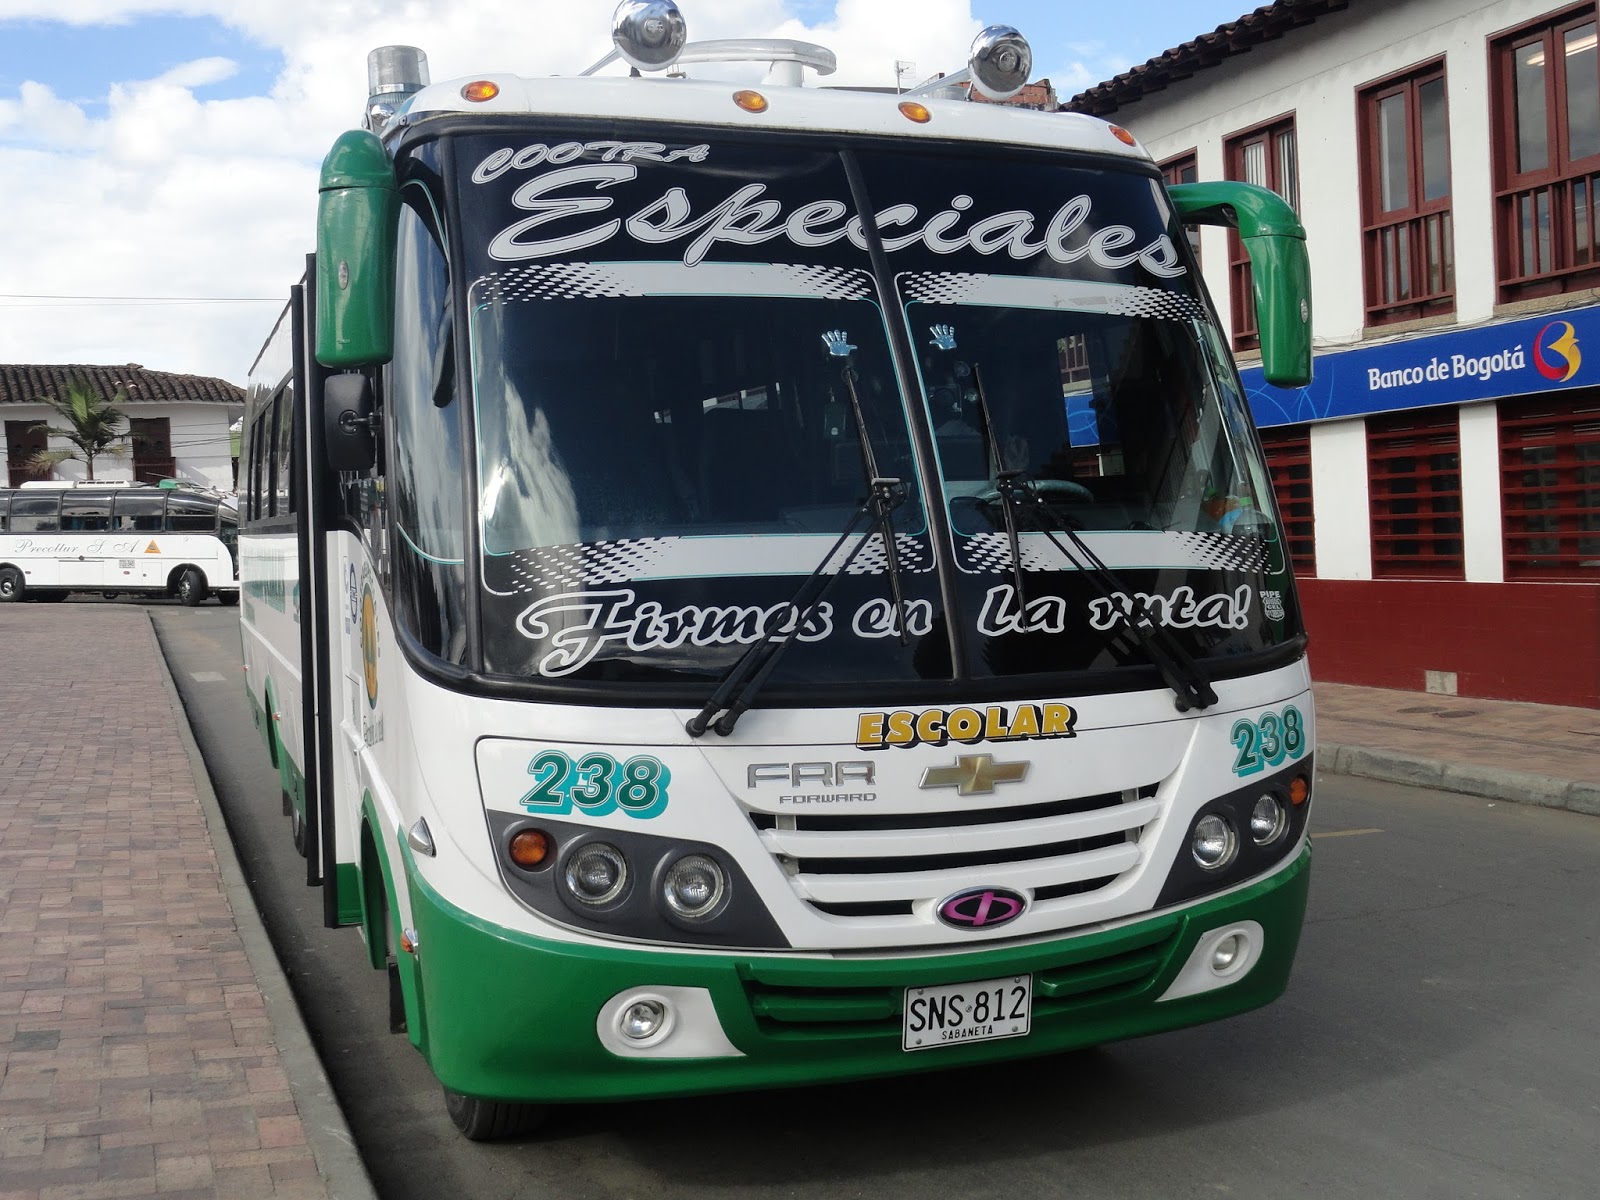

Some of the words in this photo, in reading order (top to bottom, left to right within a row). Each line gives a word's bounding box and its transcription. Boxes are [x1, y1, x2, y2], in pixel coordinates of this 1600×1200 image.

[472, 140, 710, 184] COOTRA
[488, 163, 1187, 278] Especiales
[1367, 366, 1424, 391] Banco
[1425, 357, 1450, 382] de
[1451, 344, 1526, 381] Bogotá
[1259, 590, 1281, 598] PIPE
[515, 588, 834, 678] Firmes
[852, 598, 933, 639] en
[856, 702, 1078, 751] ESCOLAR
[1230, 704, 1305, 778] 238
[519, 749, 672, 819] 238
[747, 761, 876, 789] FRR
[779, 793, 877, 805] FORWARD
[909, 995, 965, 1032] SNS
[973, 985, 1027, 1024] 812
[941, 1024, 993, 1040] SABANETA
